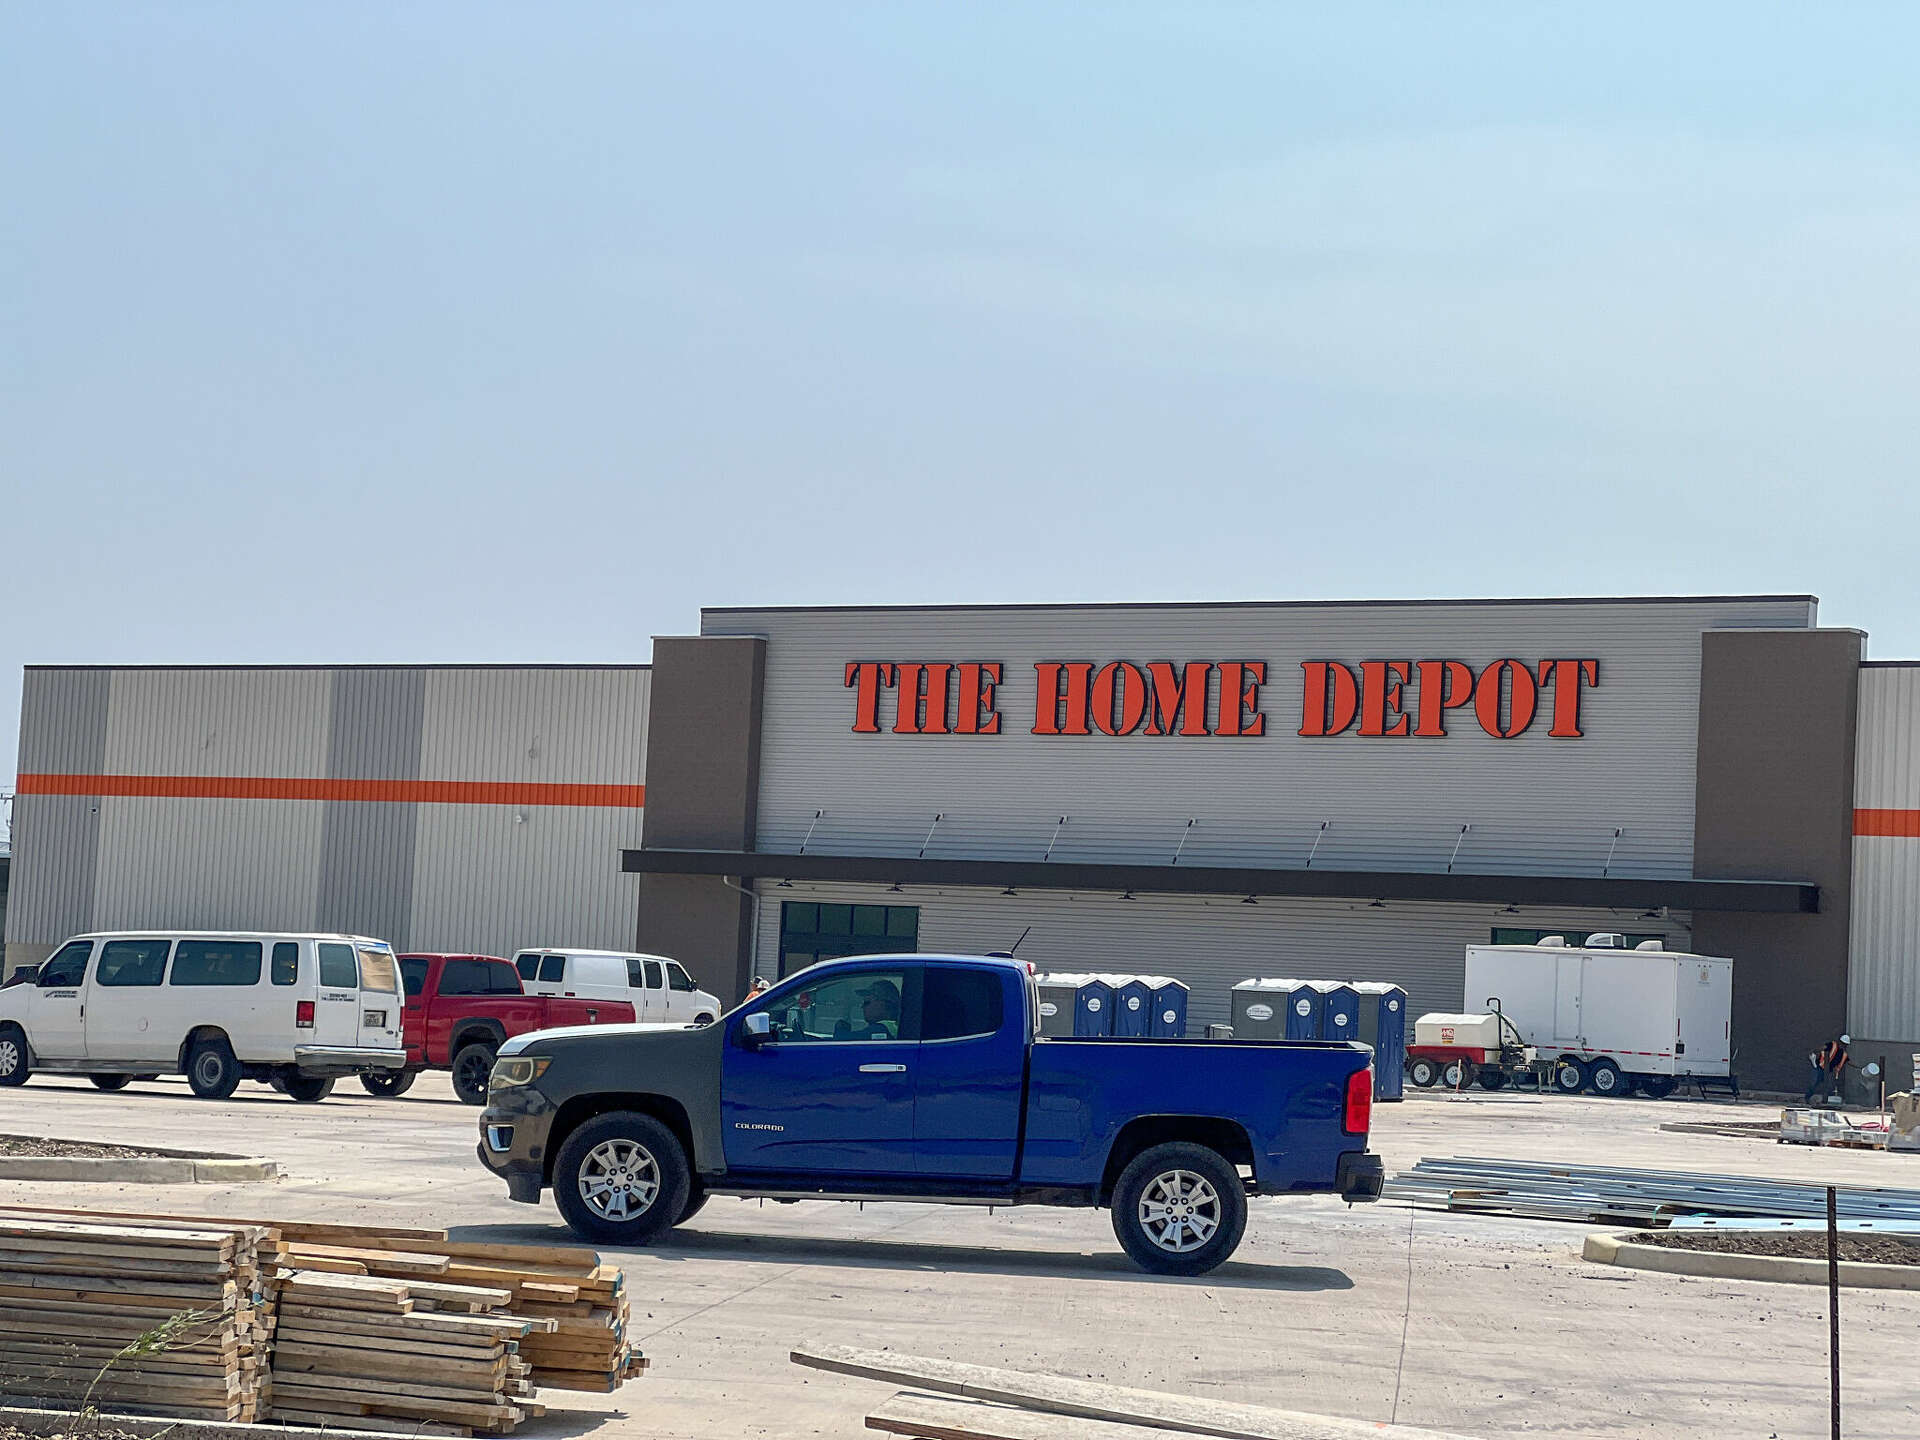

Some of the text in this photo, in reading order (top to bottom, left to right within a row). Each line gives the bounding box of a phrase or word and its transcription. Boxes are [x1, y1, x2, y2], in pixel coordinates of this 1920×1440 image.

[844, 658, 1600, 738] THE HOME DEPOT
[735, 1122, 784, 1132] COLORADO
